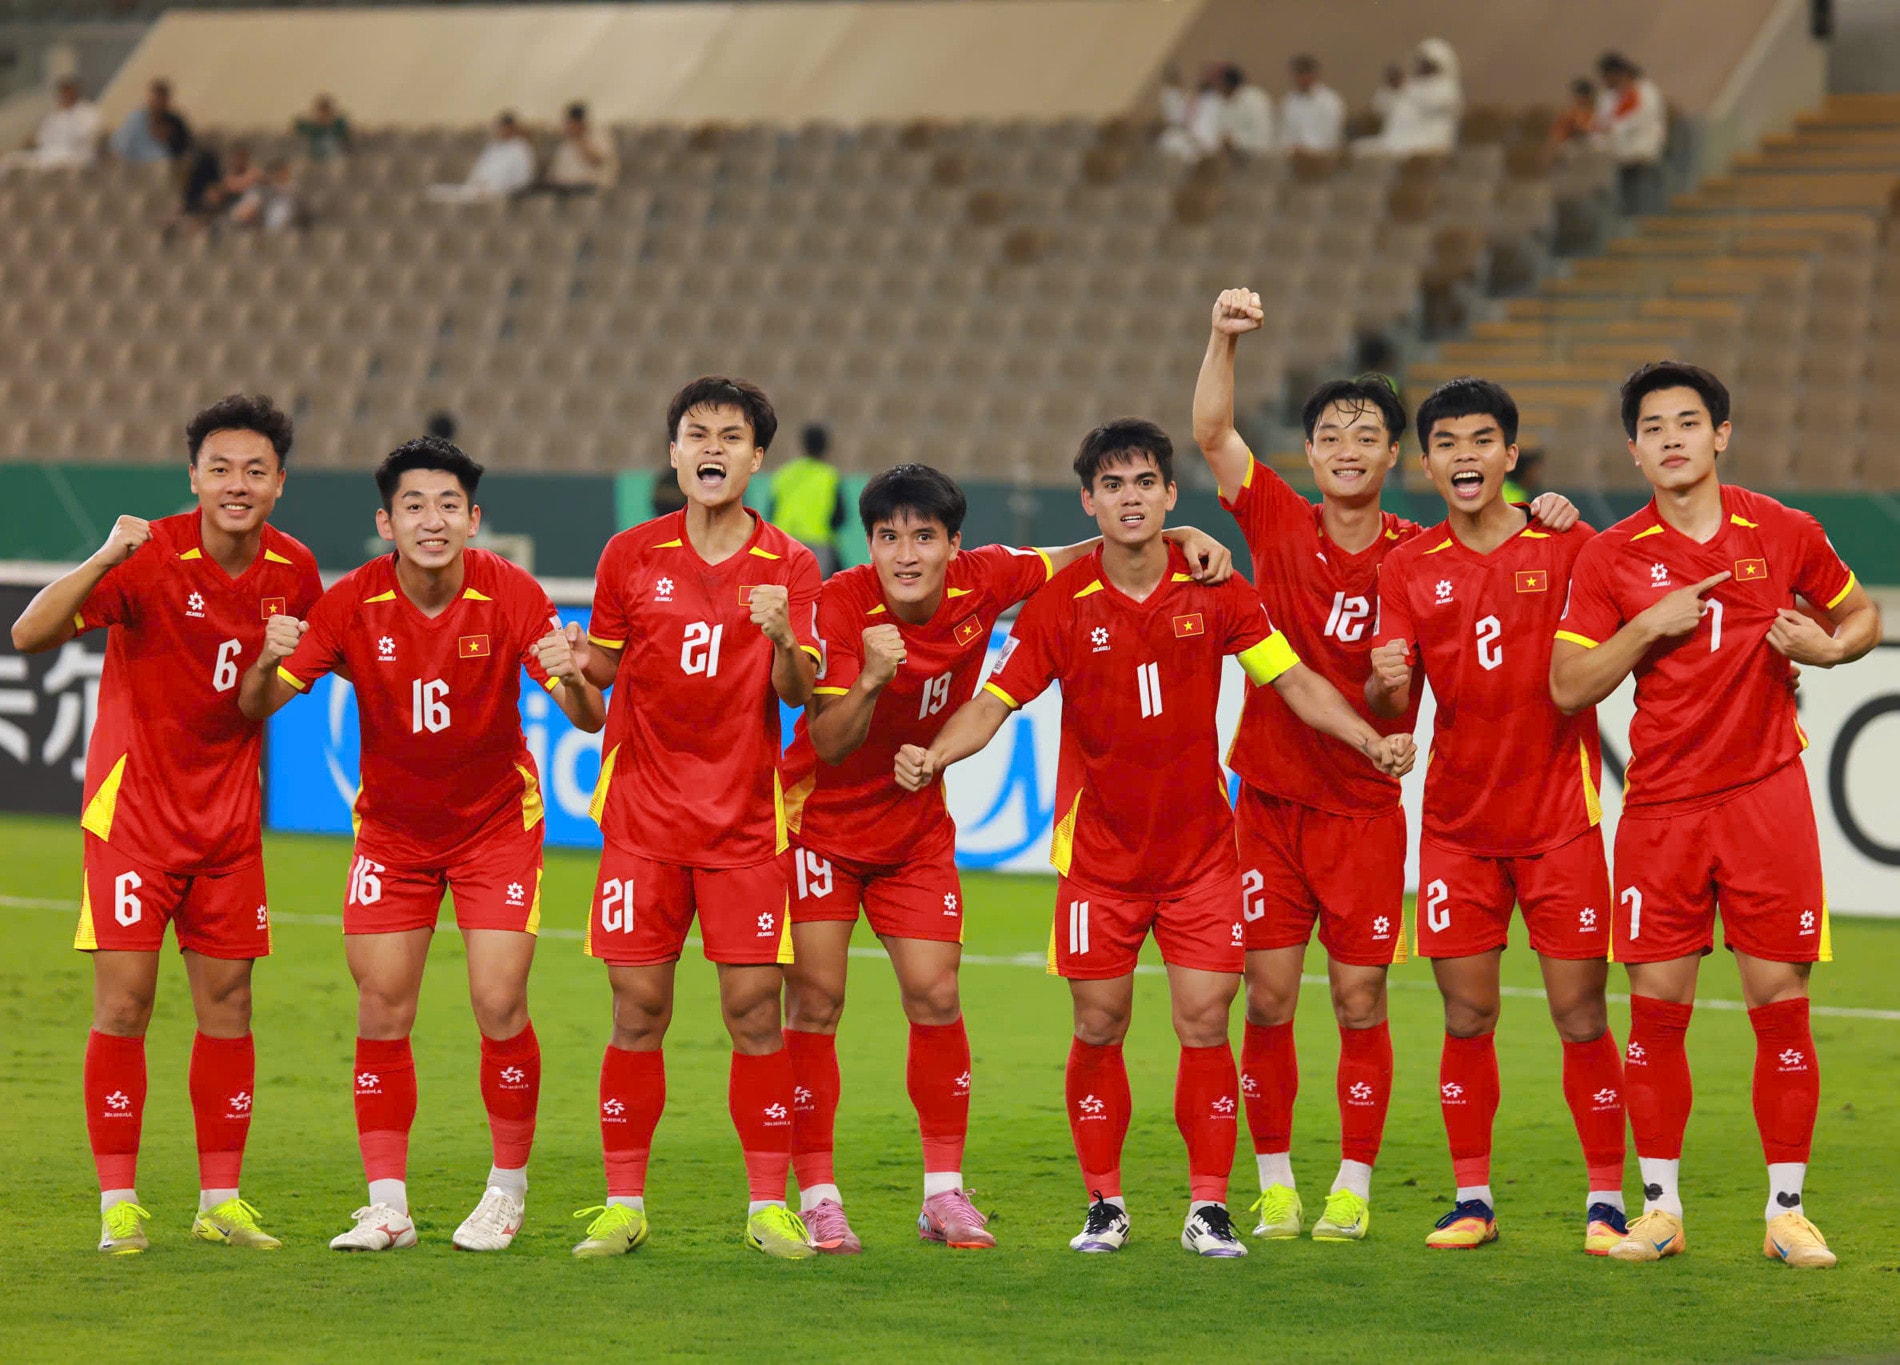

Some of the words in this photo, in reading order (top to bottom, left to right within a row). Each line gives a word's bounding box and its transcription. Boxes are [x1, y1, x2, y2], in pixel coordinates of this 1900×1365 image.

[1323, 591, 1370, 642] 12
[1475, 614, 1503, 671] 2
[1701, 597, 1723, 653] 7
[212, 638, 242, 692] 6
[680, 620, 724, 678] 21
[412, 678, 451, 734] 16
[919, 671, 952, 719] 19
[1136, 661, 1163, 719] 11
[114, 870, 142, 927] 6
[348, 854, 386, 906] 16
[795, 847, 833, 900] 19
[601, 877, 634, 934] 21
[1069, 900, 1089, 955] 11
[1427, 878, 1451, 933] 2
[1621, 885, 1643, 941] 7
